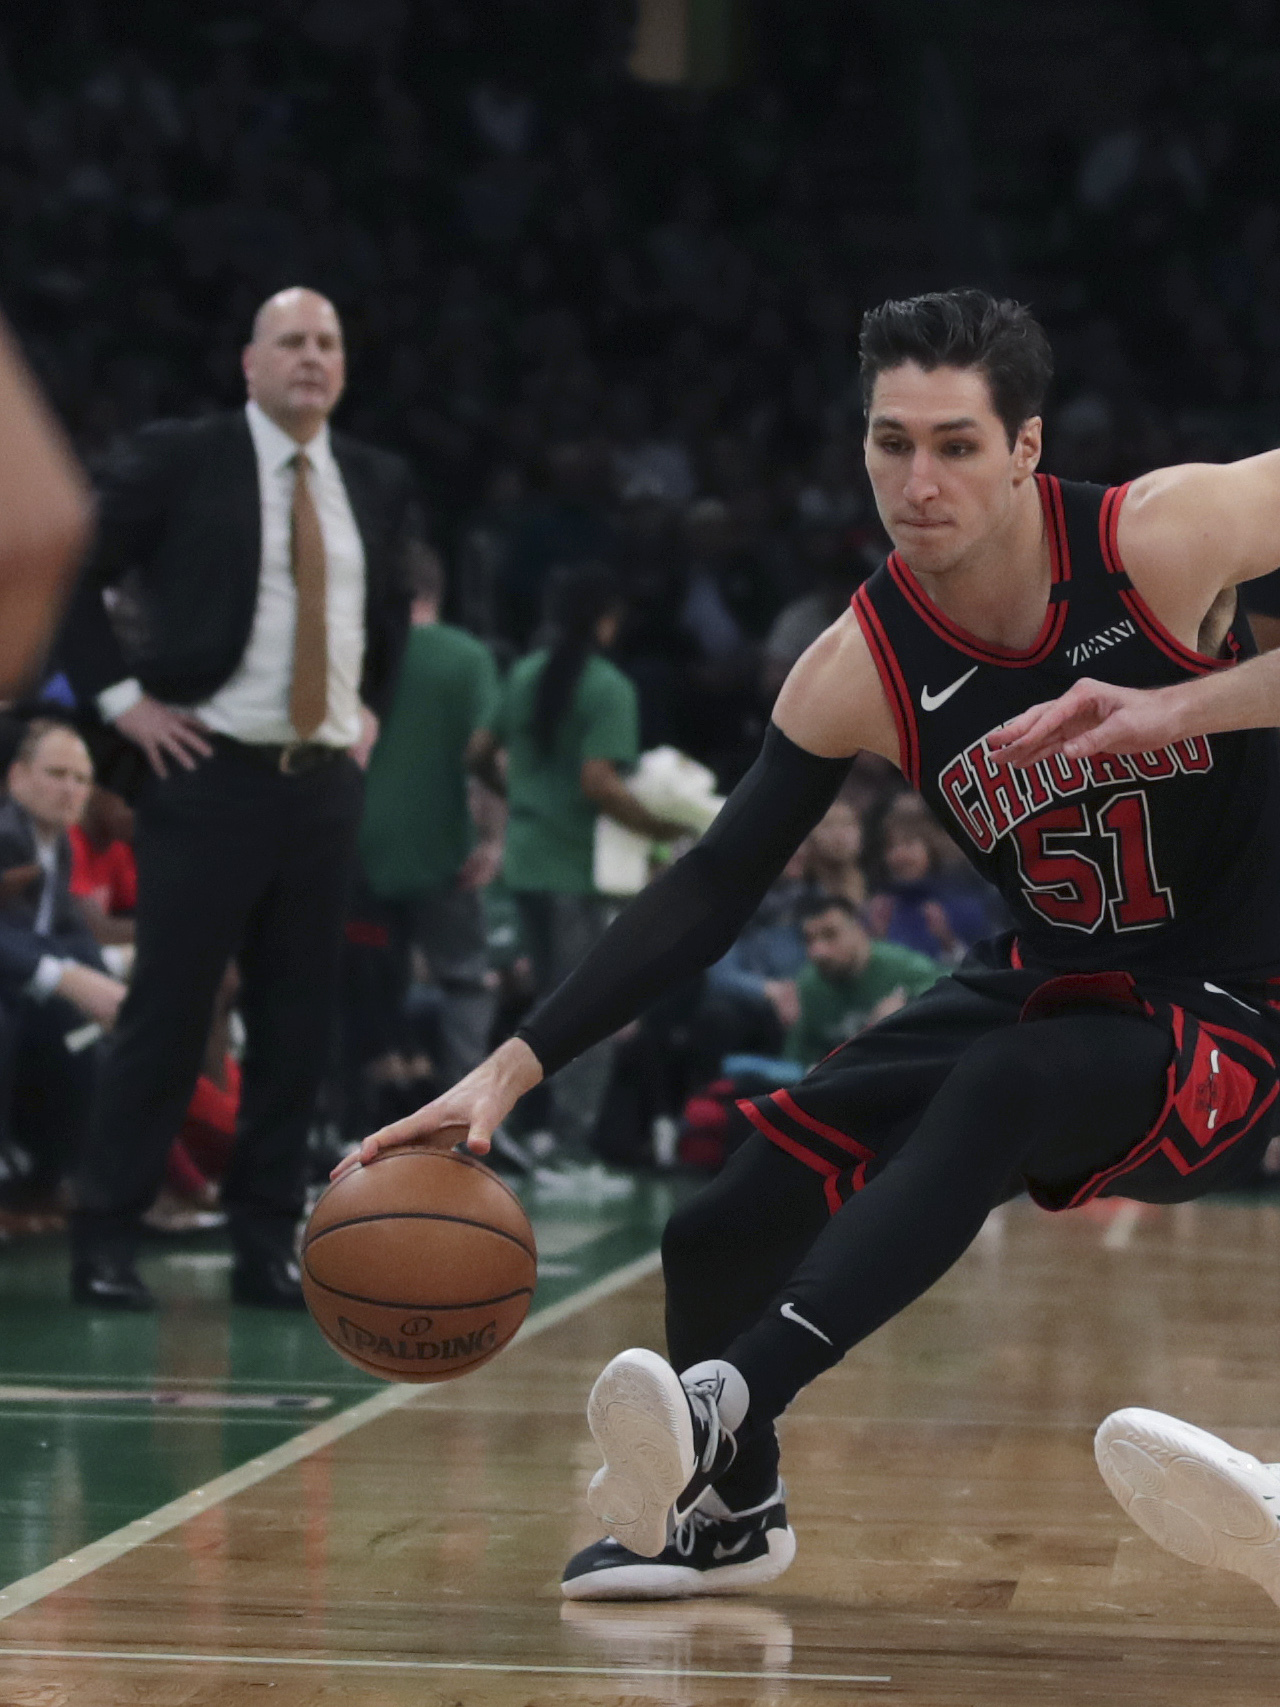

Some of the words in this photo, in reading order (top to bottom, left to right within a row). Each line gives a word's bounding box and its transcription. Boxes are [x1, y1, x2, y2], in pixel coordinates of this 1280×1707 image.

[1065, 619, 1136, 666] ZENNI
[1010, 790, 1175, 934] 51
[337, 1315, 497, 1360] SPALDING
